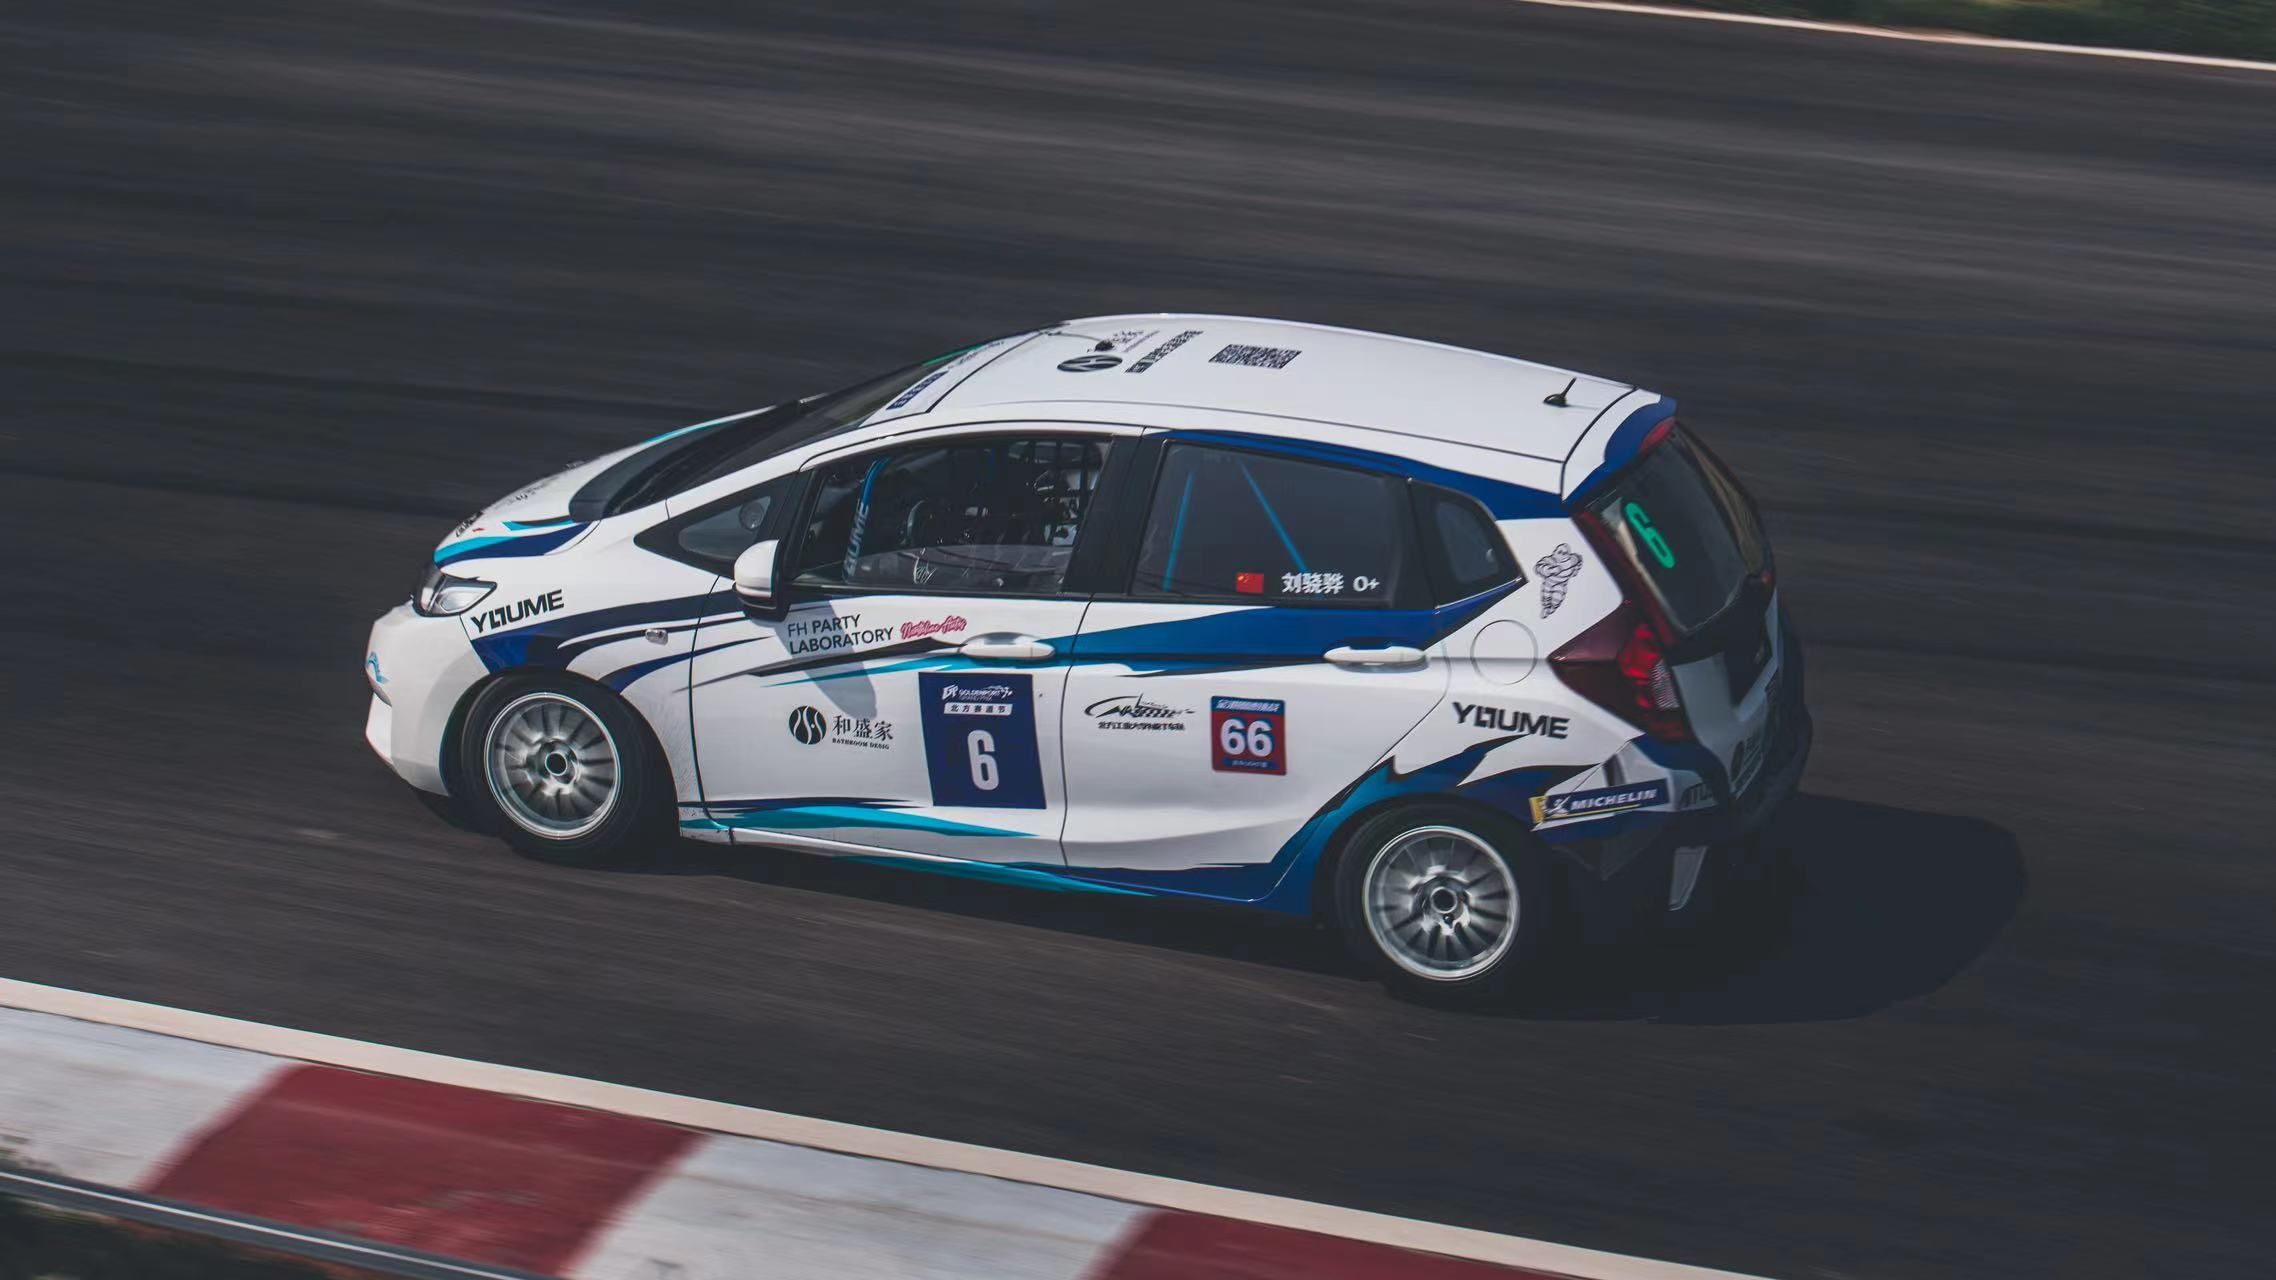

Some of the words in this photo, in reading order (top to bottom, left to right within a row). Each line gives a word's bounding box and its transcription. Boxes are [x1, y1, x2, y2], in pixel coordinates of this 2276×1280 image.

[1624, 501, 1677, 569] 6
[788, 621, 807, 637] FH
[812, 614, 861, 633] PARTY
[789, 627, 893, 654] LABORATORY
[832, 714, 893, 741] 和盛家
[1220, 718, 1273, 757] 66
[967, 729, 999, 791] 6
[1571, 788, 1658, 811] MICHELIN
